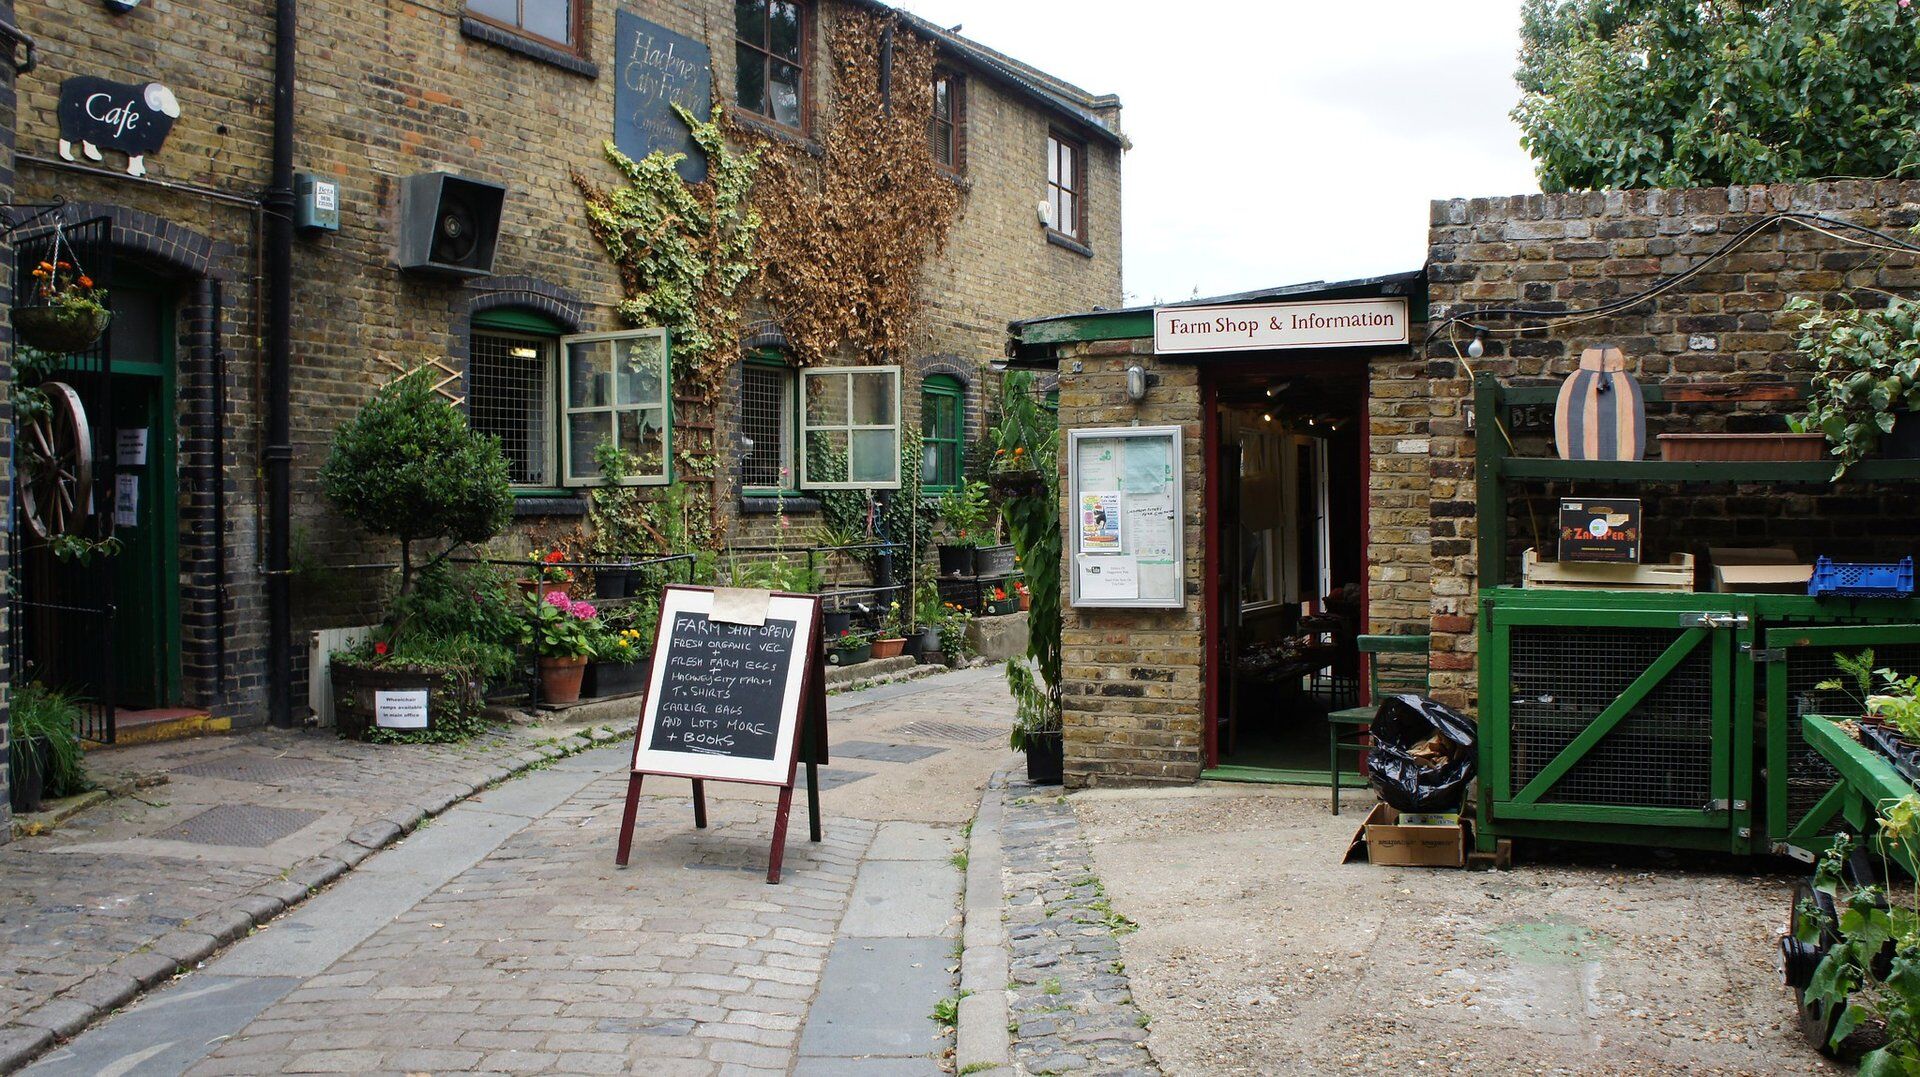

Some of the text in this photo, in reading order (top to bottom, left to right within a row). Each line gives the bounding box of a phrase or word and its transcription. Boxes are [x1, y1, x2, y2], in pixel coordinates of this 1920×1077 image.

[630, 30, 698, 89] Hackney
[624, 60, 658, 108] City
[85, 92, 140, 138] Cafe
[1169, 312, 1395, 338] Farm Shop & Information
[676, 618, 794, 639] FARM SHOP OPEN
[673, 638, 703, 649] FRESH
[707, 640, 752, 651] ORGANIC
[671, 656, 777, 672] FRESH FARM EGGS
[671, 672, 772, 689] HACKNEY CITY FARM
[662, 701, 744, 716] CARRIER BAGS
[661, 715, 774, 736] AND LOTS MORE
[683, 731, 735, 746] BOOKS
